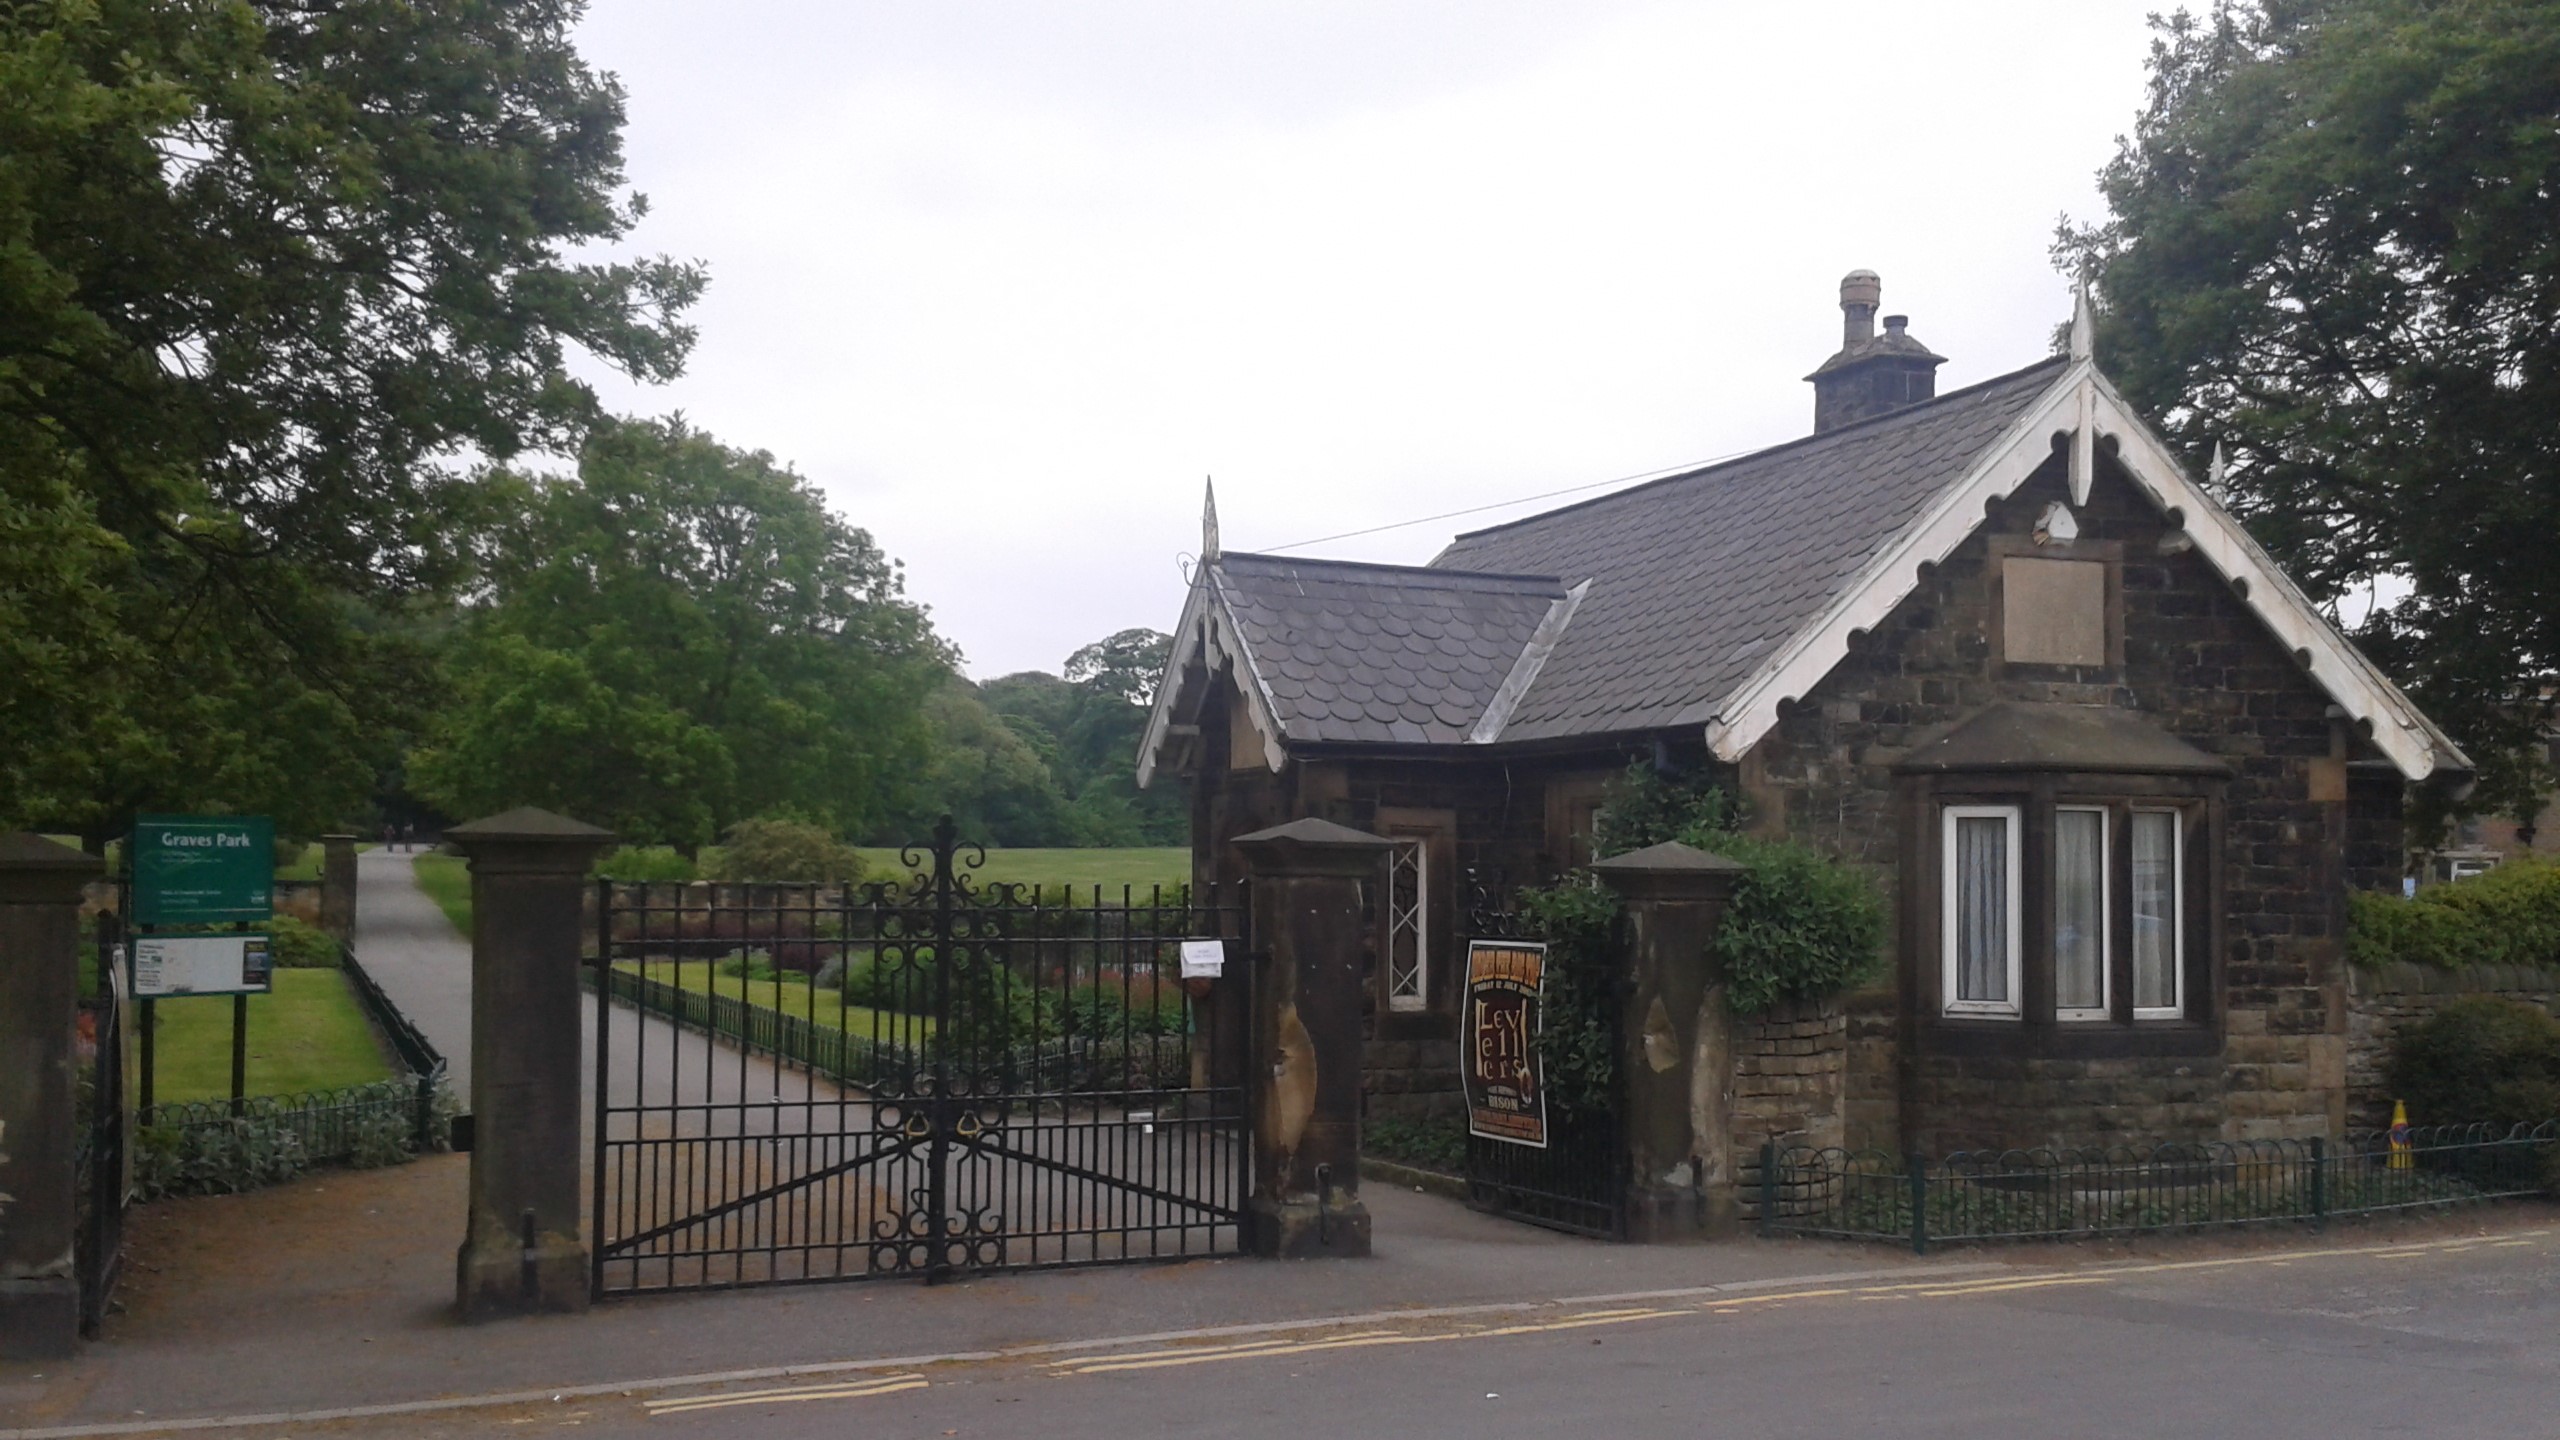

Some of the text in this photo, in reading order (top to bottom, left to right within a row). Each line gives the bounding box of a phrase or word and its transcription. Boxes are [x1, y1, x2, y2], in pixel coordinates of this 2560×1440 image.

[161, 832, 251, 849] Graves Park
[1487, 1094, 1519, 1112] BISON
